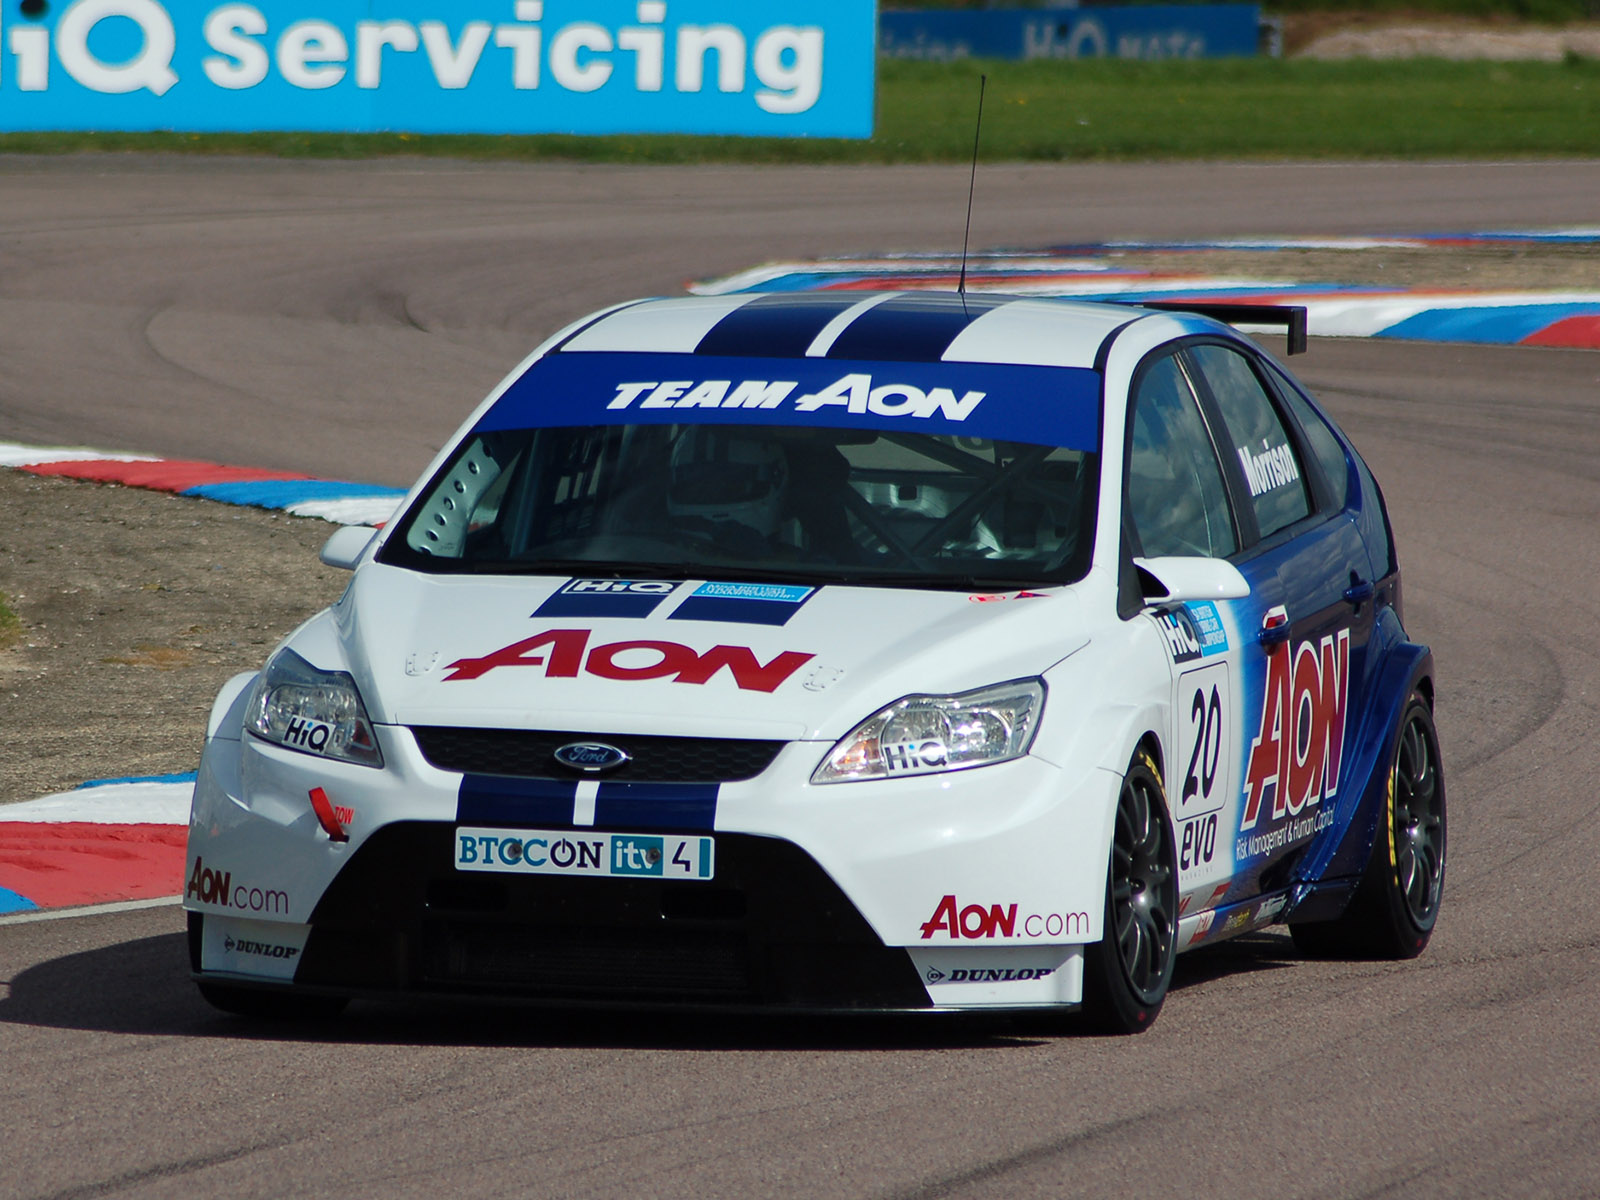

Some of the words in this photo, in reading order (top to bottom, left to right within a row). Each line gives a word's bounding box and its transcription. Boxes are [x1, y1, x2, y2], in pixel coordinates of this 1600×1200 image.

[203, 0, 825, 114] Servicing
[606, 380, 799, 410] TEAM
[795, 373, 987, 421] AON
[1238, 438, 1299, 497] Morrison
[572, 580, 674, 593] HiQ
[1157, 611, 1200, 656] HiQ
[440, 628, 818, 693] AON
[283, 717, 330, 752] HiQ
[1240, 604, 1350, 833] AON
[569, 745, 609, 762] Ford
[885, 741, 947, 770] HiQ
[1182, 683, 1222, 806] 20
[1180, 813, 1218, 871] evo
[1236, 837, 1248, 861] Risk
[1248, 822, 1288, 856] Management
[1287, 821, 1294, 843] &
[1293, 817, 1314, 840] Human
[1314, 803, 1336, 834] Capital
[616, 840, 660, 870] itv
[672, 842, 691, 872] 4
[188, 856, 288, 914] AON.com
[919, 895, 1090, 939] AON.com
[236, 939, 299, 959] DUNLOP
[948, 968, 1056, 982] DUNLOP
